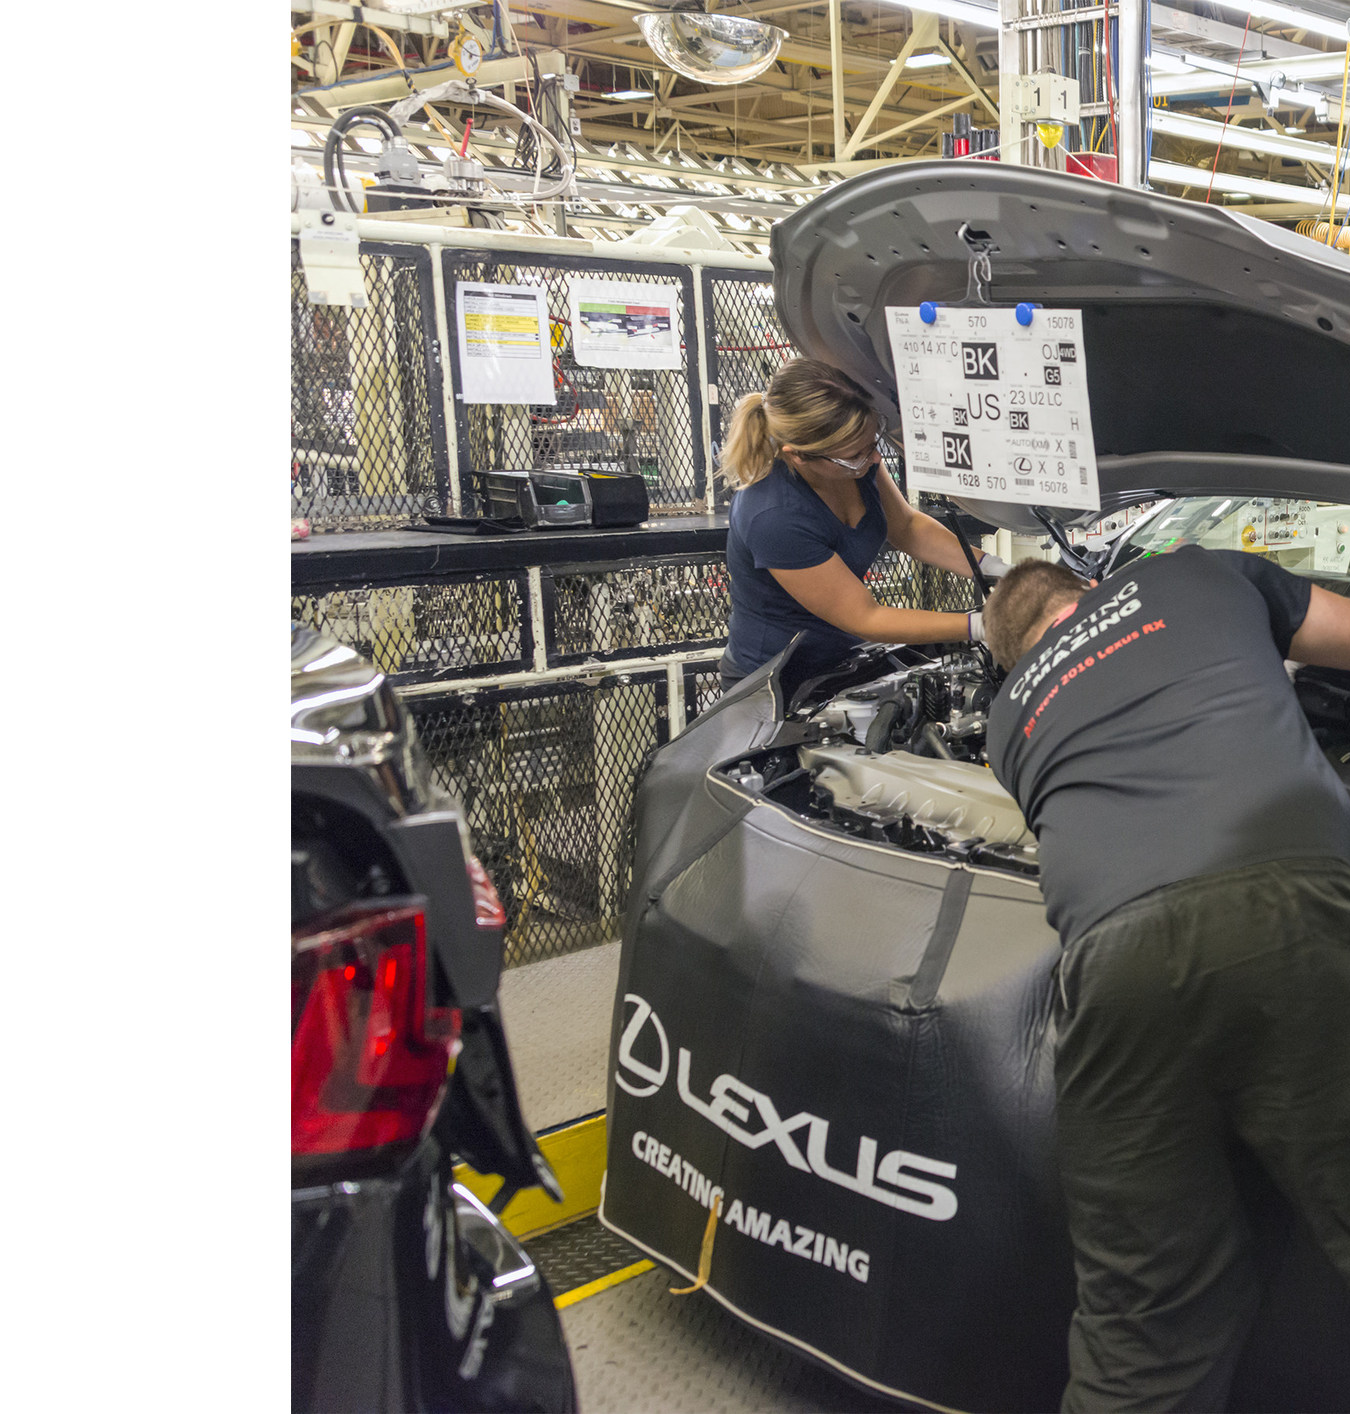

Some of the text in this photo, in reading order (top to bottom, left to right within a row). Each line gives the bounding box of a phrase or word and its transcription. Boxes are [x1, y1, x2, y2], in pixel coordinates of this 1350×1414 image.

[1033, 86, 1041, 107] 1
[1060, 90, 1067, 110] 1
[968, 316, 987, 328] 570
[1047, 317, 1075, 329] 15078
[903, 341, 959, 357] 410 14 XT C
[909, 362, 920, 376] J4
[963, 347, 999, 376] BK
[1045, 369, 1061, 383] G5
[966, 392, 1001, 421] US
[1009, 390, 1063, 407] 23 U2 LC
[912, 405, 925, 420] C1
[953, 410, 968, 425] BK
[1010, 413, 1029, 428] BK
[1071, 417, 1080, 431] H
[945, 436, 972, 467] BK
[1055, 440, 1064, 453] X
[1038, 461, 1047, 474] X
[1057, 462, 1065, 476] 8
[957, 473, 1007, 491] 1628 570
[1039, 480, 1068, 494] 15078
[1009, 580, 1139, 700] CREATING
[1021, 598, 1142, 706] AMAZING
[1024, 716, 1037, 739] All
[1060, 656, 1096, 686] 2016
[1097, 631, 1141, 660] Lexus
[1142, 619, 1167, 635] RX
[677, 1047, 959, 1222] LEXUS
[631, 1130, 870, 1284] CREATING AMAZING
